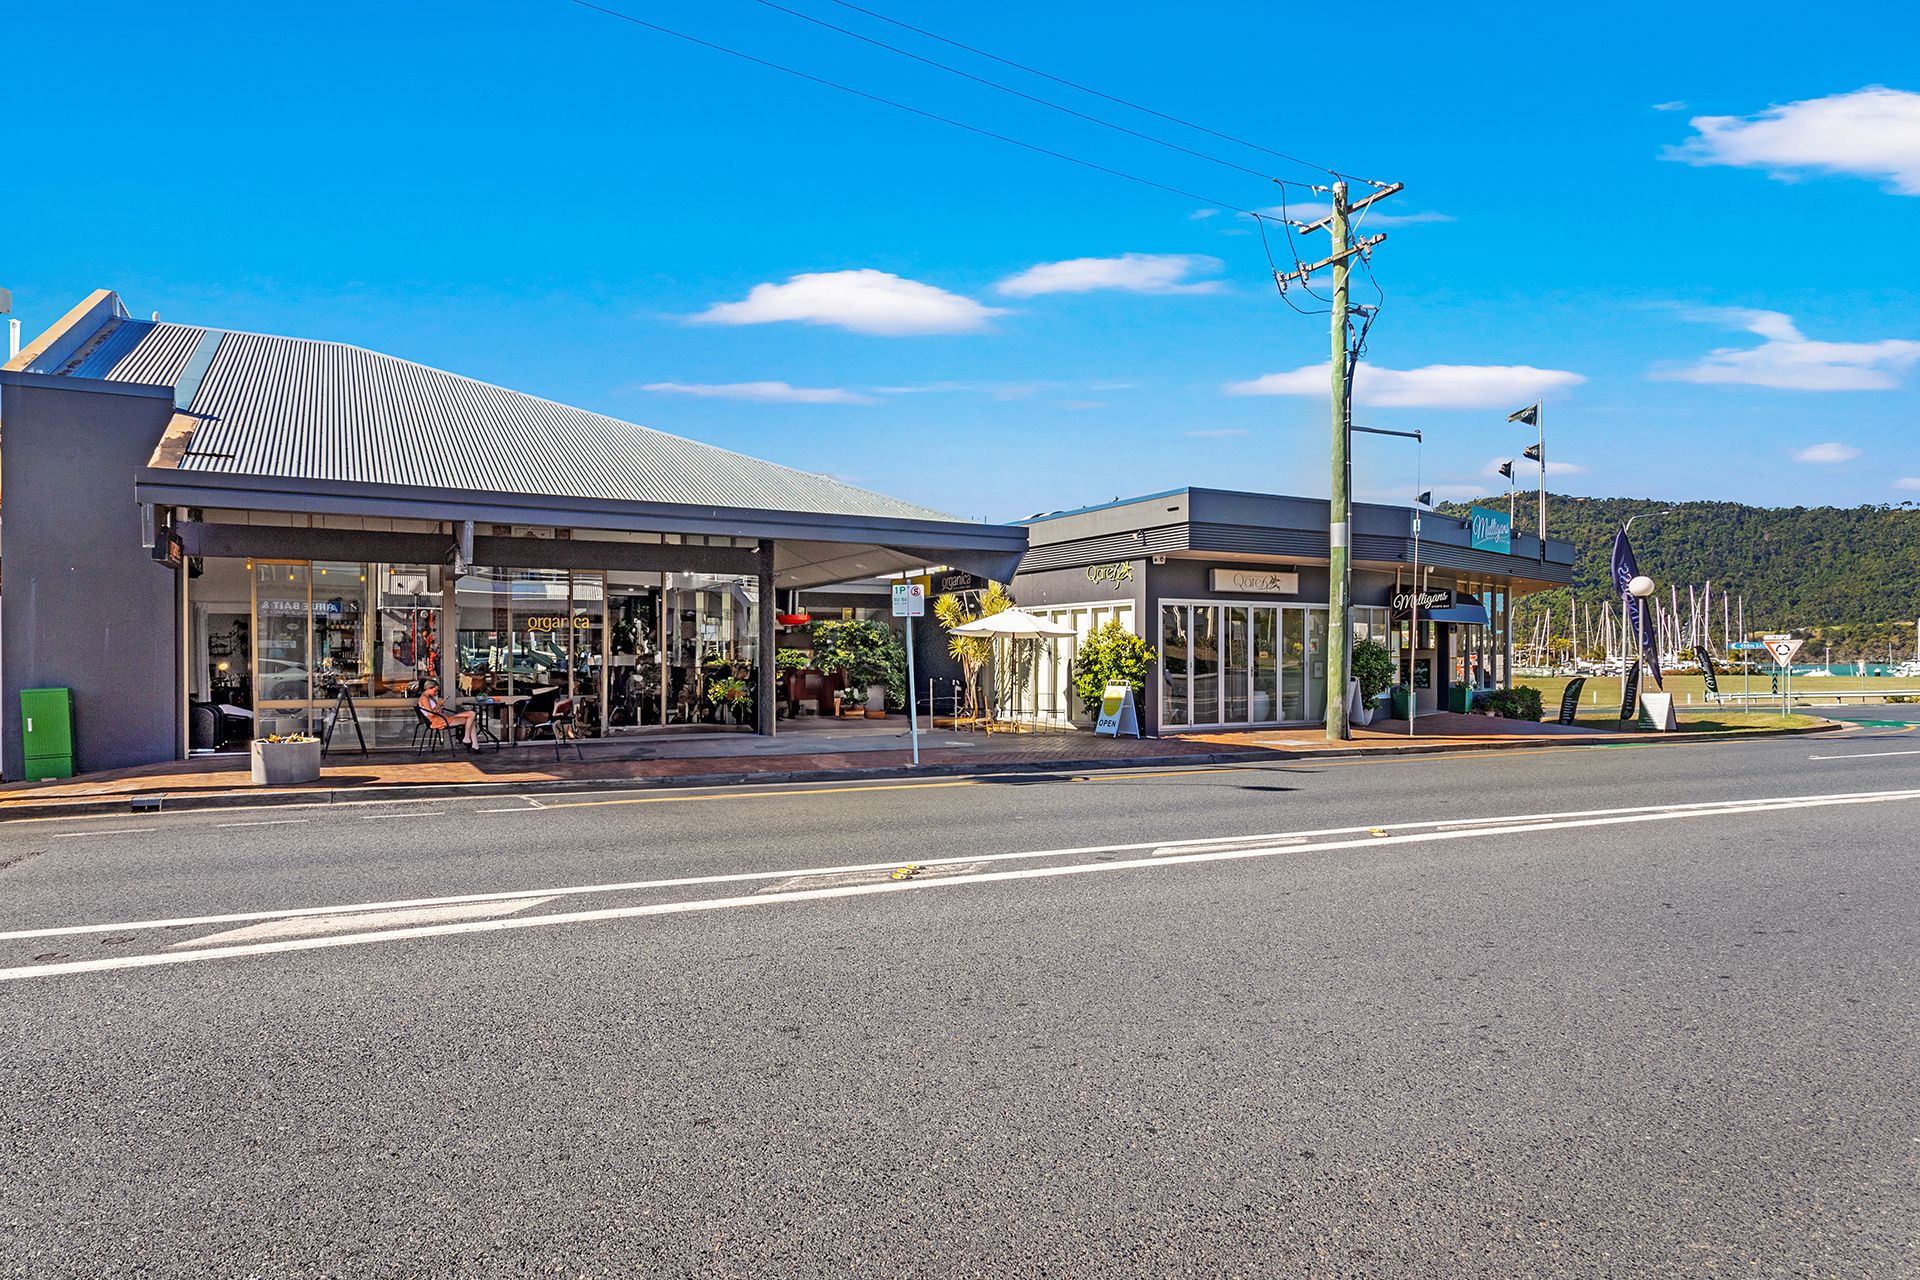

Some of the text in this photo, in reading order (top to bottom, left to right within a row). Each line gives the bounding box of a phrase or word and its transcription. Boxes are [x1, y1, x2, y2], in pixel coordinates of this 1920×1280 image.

[942, 572, 972, 591] organica
[895, 586, 906, 594] 1P
[527, 617, 590, 632] organca
[1098, 719, 1117, 727] OPEN
